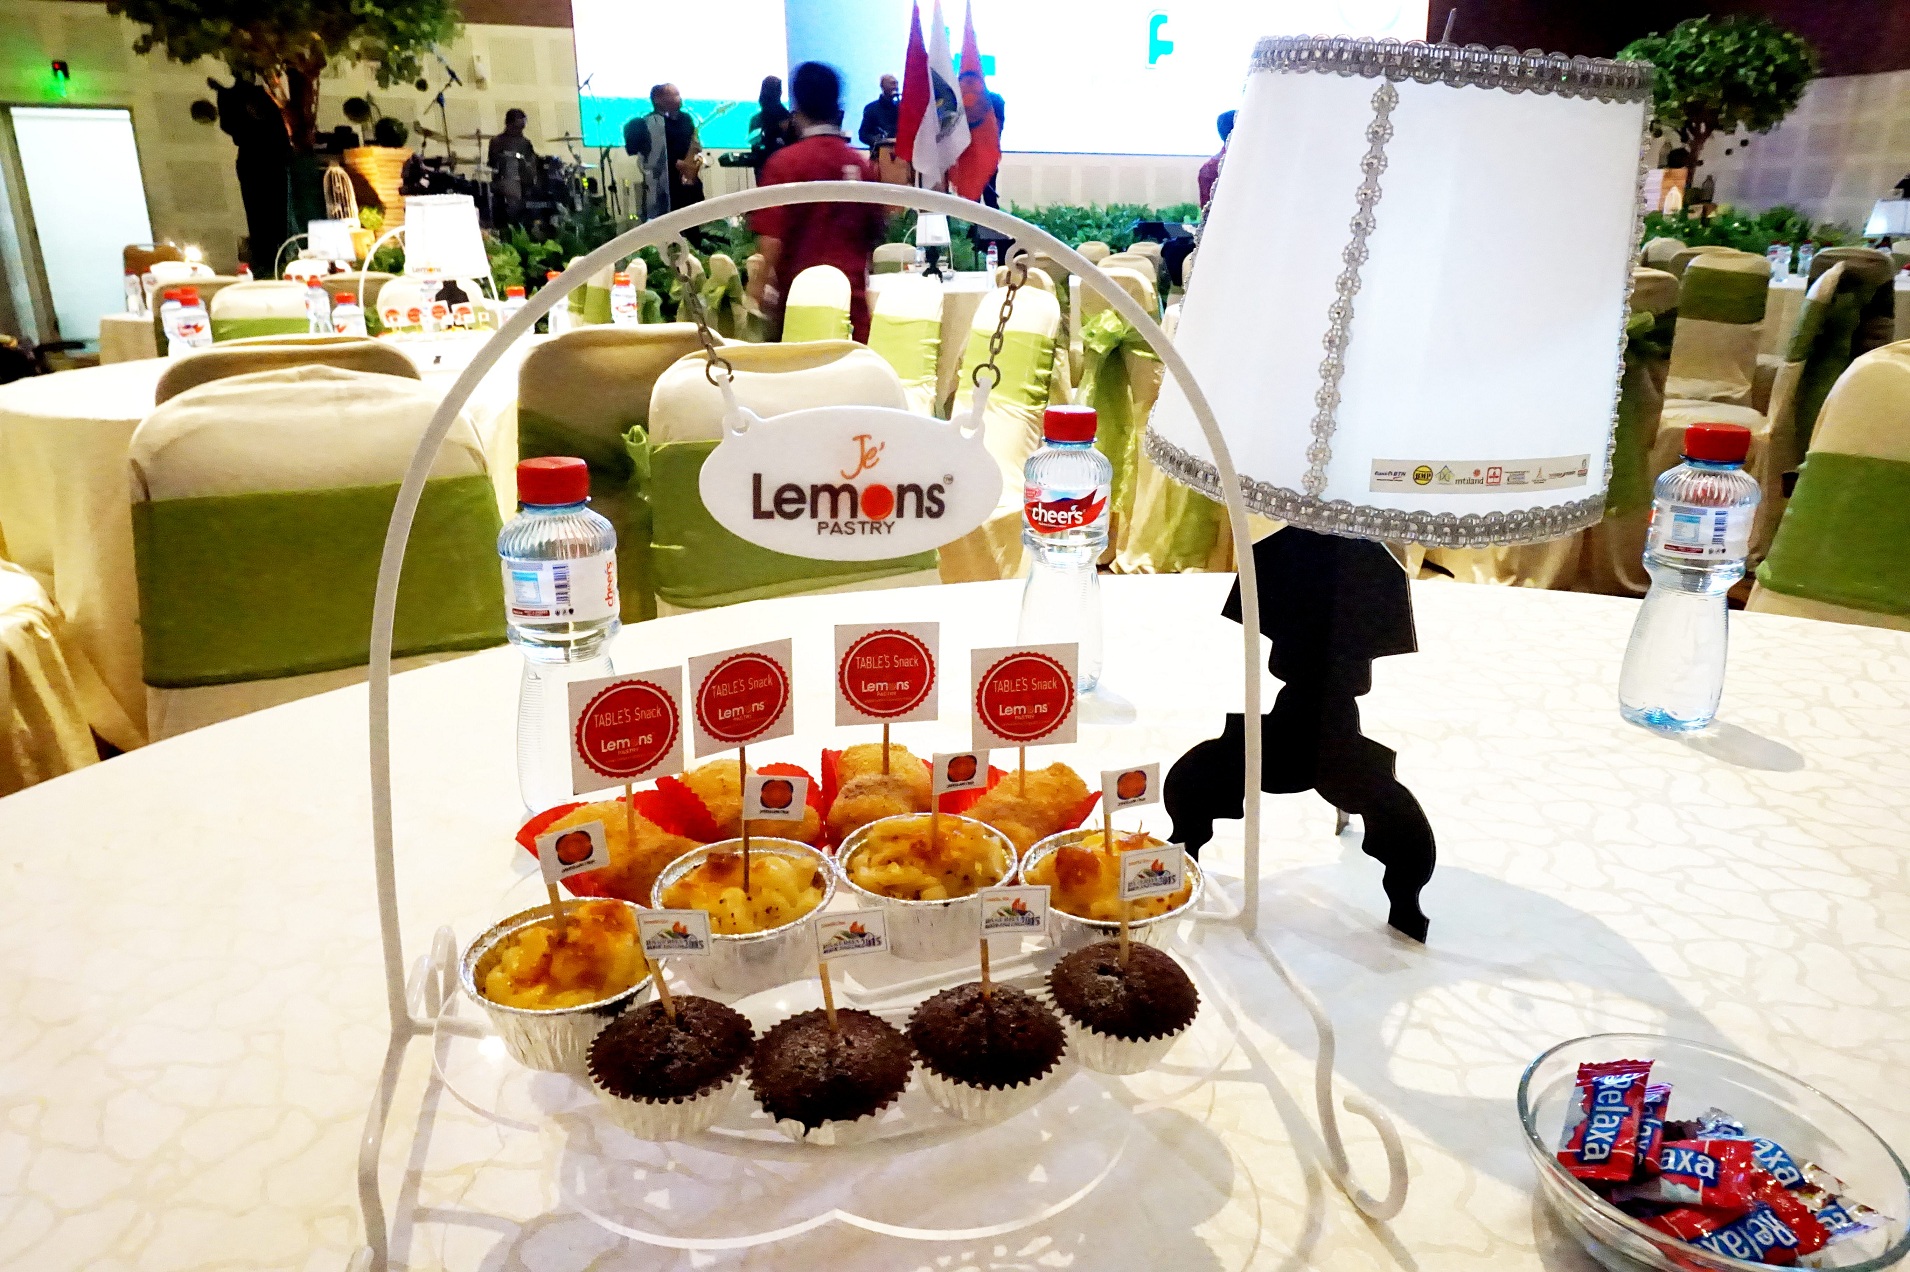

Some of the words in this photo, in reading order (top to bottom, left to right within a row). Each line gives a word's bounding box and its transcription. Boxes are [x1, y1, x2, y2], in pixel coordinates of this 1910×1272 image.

[752, 473, 946, 520] Lemons
[817, 520, 896, 536] PASTRY
[855, 654, 890, 670] TABLE'S
[893, 655, 919, 668] Snack
[711, 679, 746, 699] TABLE'S
[748, 674, 773, 690] Snack
[993, 677, 1028, 693] TABLE'S
[1031, 677, 1058, 691] Snack
[594, 708, 631, 728] TABLE'S
[634, 704, 662, 722] Snack
[1702, 1209, 1799, 1261] Relax
